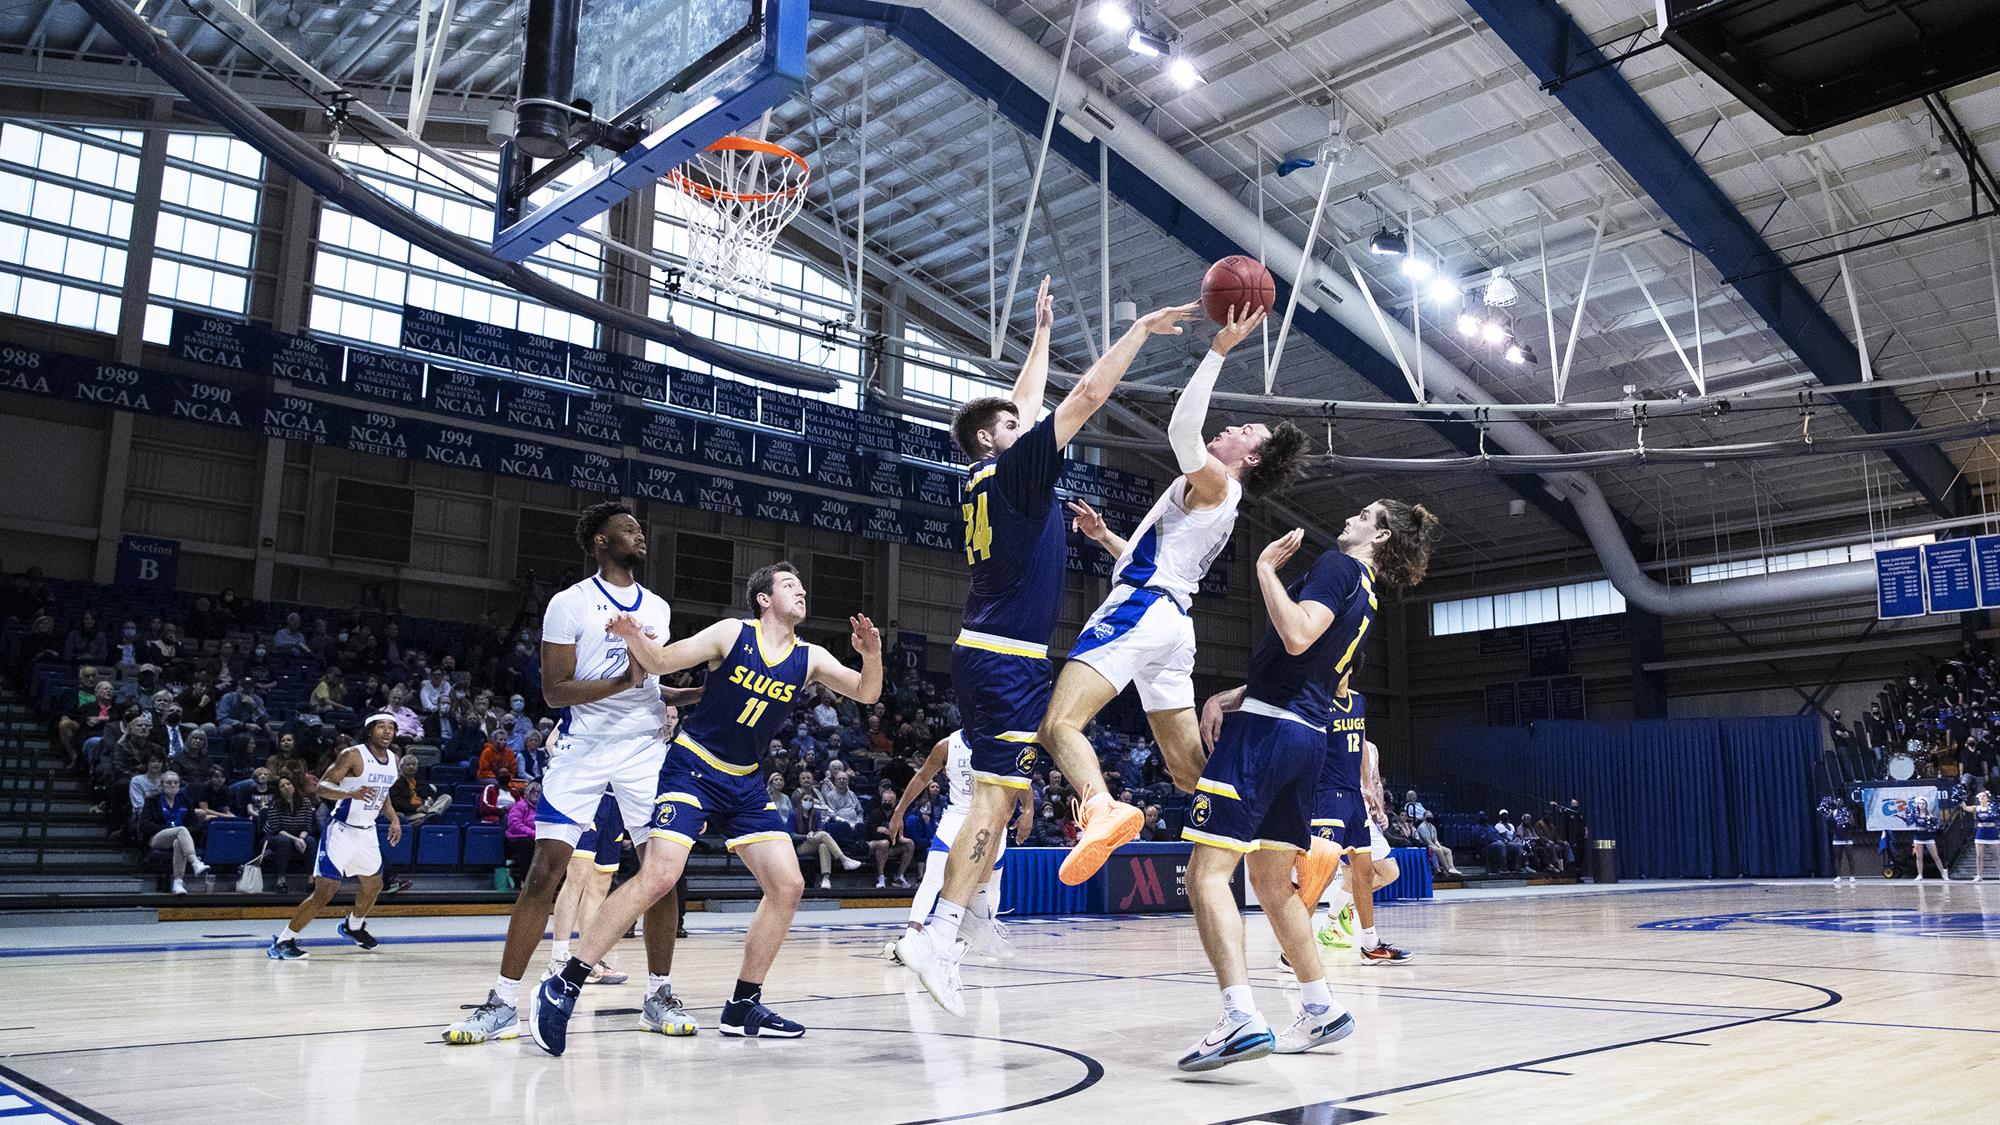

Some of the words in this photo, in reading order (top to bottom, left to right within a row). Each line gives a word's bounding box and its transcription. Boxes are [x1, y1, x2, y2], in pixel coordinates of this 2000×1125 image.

[419, 311, 446, 326] 2001
[202, 319, 233, 336] 1982
[405, 320, 456, 338] VOLLEYBALL
[475, 323, 503, 338] 2002
[184, 335, 246, 352] BASKETBALL
[289, 338, 318, 354] 1986
[403, 330, 457, 355] NCAA
[463, 333, 511, 351] VOLLEYBALL
[528, 335, 554, 350] 2004
[2, 347, 41, 369] 988
[183, 344, 243, 368] NCAA
[272, 352, 330, 371] BASKETBALL
[461, 344, 512, 367] NCAA
[518, 345, 563, 362] VOLLEYBALL
[581, 349, 607, 363] 2005
[352, 352, 376, 367] 1992
[380, 358, 420, 375] NCAA
[515, 356, 564, 379] NCAA
[571, 358, 615, 375] VOLLEYBALL
[632, 360, 657, 374] 2007
[0, 368, 51, 393] CAA
[95, 366, 140, 386] 1989
[272, 362, 329, 386] NCAA
[357, 373, 412, 389] BASKETBALL
[451, 373, 476, 387] 1993
[569, 368, 617, 390] NCAA
[622, 370, 663, 386] VOLLEYBALL
[681, 372, 704, 386] 2008
[76, 382, 151, 411] NCAA
[191, 383, 231, 404] 1990
[354, 382, 398, 398] SWEET
[402, 392, 412, 402] 16
[436, 388, 486, 402] BASKETBALL
[522, 387, 546, 401] 1995
[620, 379, 665, 400] NCAA
[672, 382, 711, 398] VOLLEYBALL
[735, 383, 757, 398] NCAA
[283, 397, 313, 414] 1991
[435, 396, 486, 416] NCAA
[590, 401, 613, 414] 1997
[670, 390, 713, 411] NCAA
[778, 393, 801, 408] NCAA
[172, 399, 243, 426] NCAA
[718, 400, 744, 417] Elite
[750, 408, 757, 420] 8
[806, 401, 823, 413] 2011
[826, 405, 855, 419] NCAA
[263, 408, 328, 434] NCAA
[366, 413, 396, 429] 1993
[508, 410, 555, 431] NCAA
[655, 415, 677, 427] 1998
[762, 411, 790, 428] Elite
[795, 419, 801, 430] 8
[806, 413, 855, 430] VOLLEYBALL
[873, 416, 895, 429] NCAA
[264, 425, 310, 441] SWEET
[315, 434, 326, 445] 16
[350, 425, 407, 448] NCAA
[440, 430, 473, 448] 1994
[577, 422, 621, 442] NCAA
[714, 427, 736, 440] 2001
[806, 425, 855, 443] NATIONAL
[909, 423, 931, 438] 2013
[642, 435, 684, 455] NCAA
[772, 440, 793, 452] 2002
[807, 434, 852, 450] RUNNER-UP
[897, 432, 942, 449] VOLLEYBALL
[348, 440, 392, 457] SWEET
[397, 448, 408, 459] 16
[425, 444, 483, 469] NCAA
[514, 443, 544, 460] 1995
[704, 448, 743, 466] NCAA
[901, 442, 938, 461] NCAA
[585, 453, 610, 468] 1996
[762, 459, 800, 477] NCAA
[500, 458, 553, 481] NCAA
[572, 464, 618, 485] NCAA
[648, 468, 676, 484] 1997
[570, 479, 607, 493] SWEET
[610, 486, 620, 495] 16
[712, 477, 734, 491] 1998
[818, 470, 853, 487] NCAA
[1066, 479, 1096, 493] NCAA
[636, 481, 684, 503] NCAA
[870, 480, 904, 497] NCAA
[1097, 487, 1125, 502] NCAA
[699, 488, 742, 507] NCAA
[767, 490, 793, 505] 1999
[920, 491, 952, 507] NCAA
[1126, 493, 1155, 507] NCAA
[699, 501, 731, 515] SWEET
[735, 508, 743, 517] 16
[757, 503, 801, 524] NCAA
[821, 500, 849, 516] 2000
[874, 508, 897, 521] 2001
[1105, 508, 1126, 521] NCAA
[812, 513, 853, 533] NCAA
[868, 518, 904, 535] NCAA
[923, 519, 948, 534] 2003
[962, 491, 993, 566] 24
[863, 530, 885, 541] ELITE
[886, 534, 911, 545] EIGHT
[915, 531, 952, 549] NCAA
[129, 540, 173, 555] Section
[139, 559, 160, 580] B
[1202, 582, 1228, 593] NCAA
[906, 651, 918, 668] D
[729, 665, 797, 703] SLUGS
[736, 697, 769, 728] 11
[1332, 718, 1366, 732] SLUGS
[1346, 733, 1360, 753] 12
